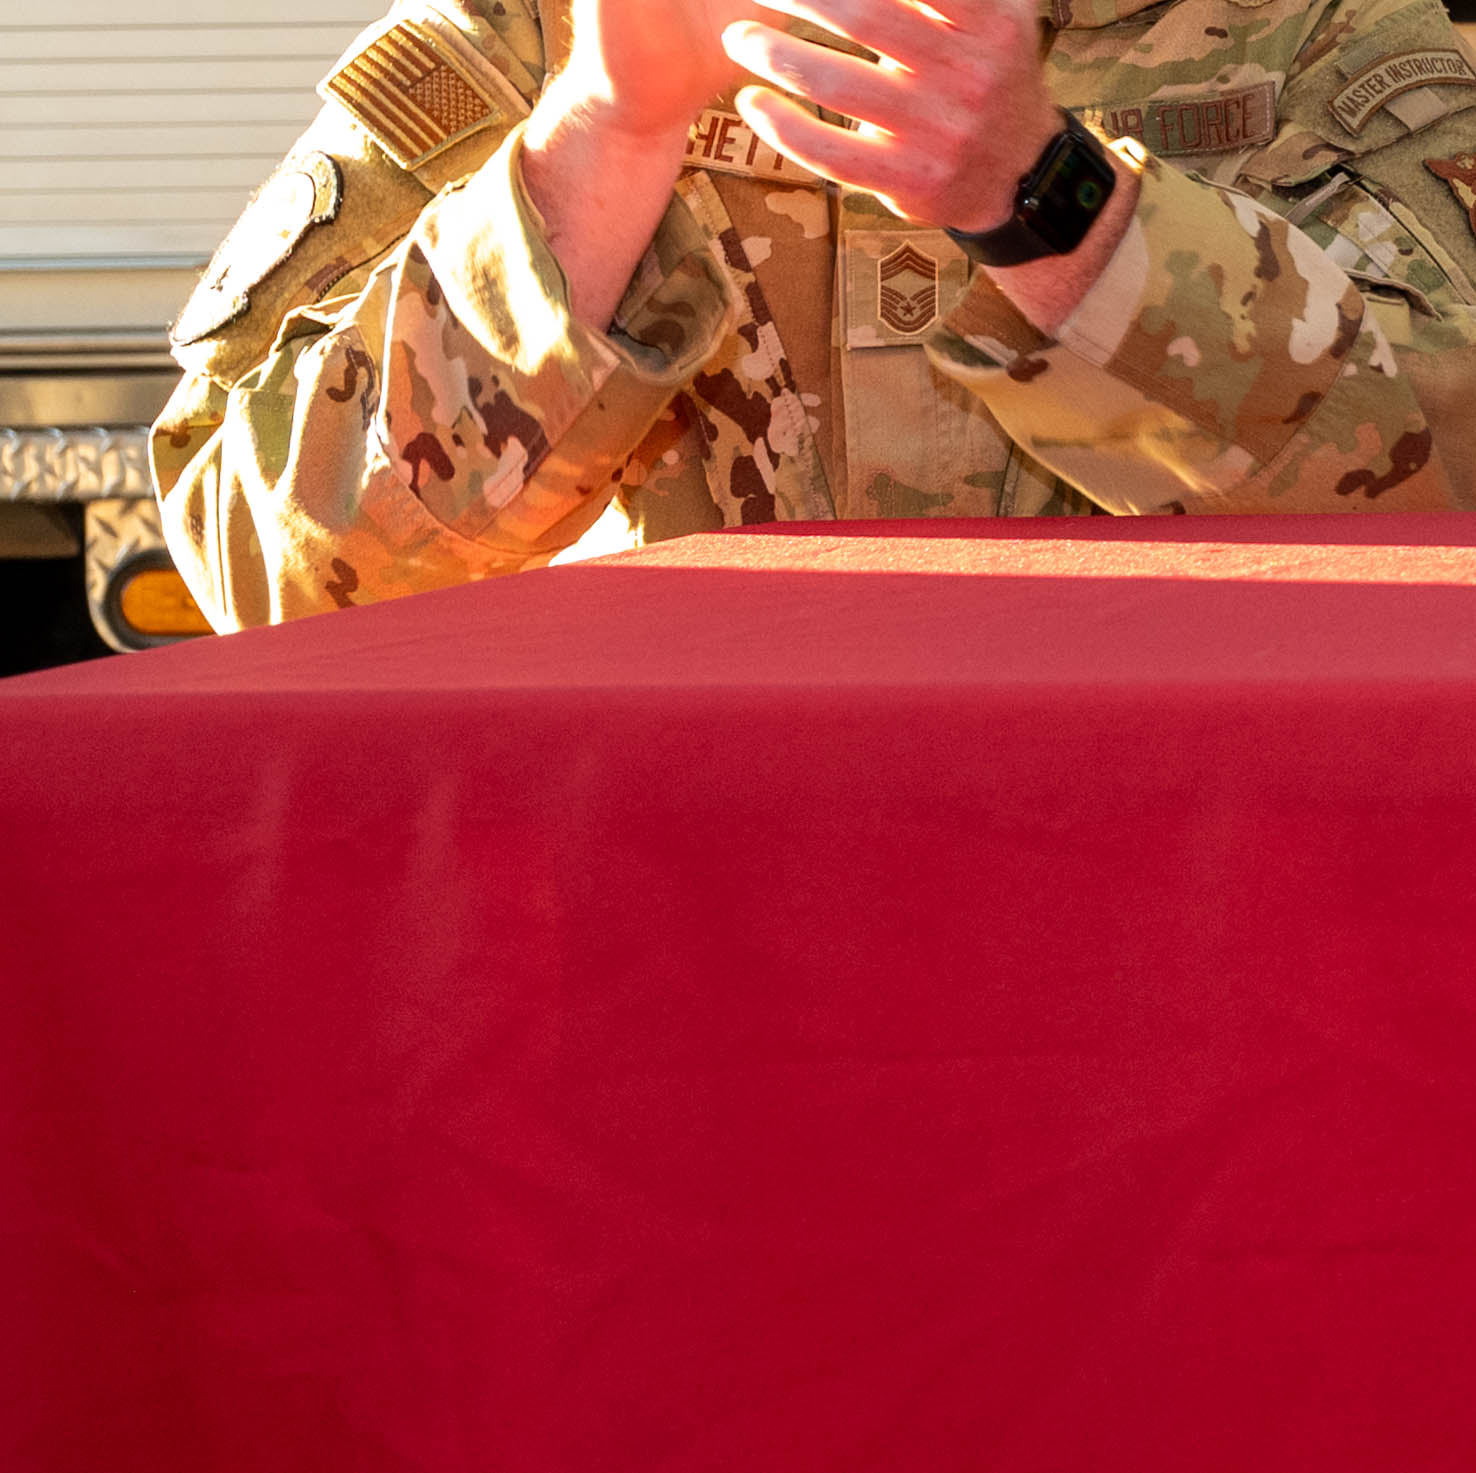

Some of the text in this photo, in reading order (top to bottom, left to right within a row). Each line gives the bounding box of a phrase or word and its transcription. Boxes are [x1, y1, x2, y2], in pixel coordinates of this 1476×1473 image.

[1337, 56, 1467, 119] MASTER INSTRUCTOR
[1157, 94, 1256, 150] FORCE
